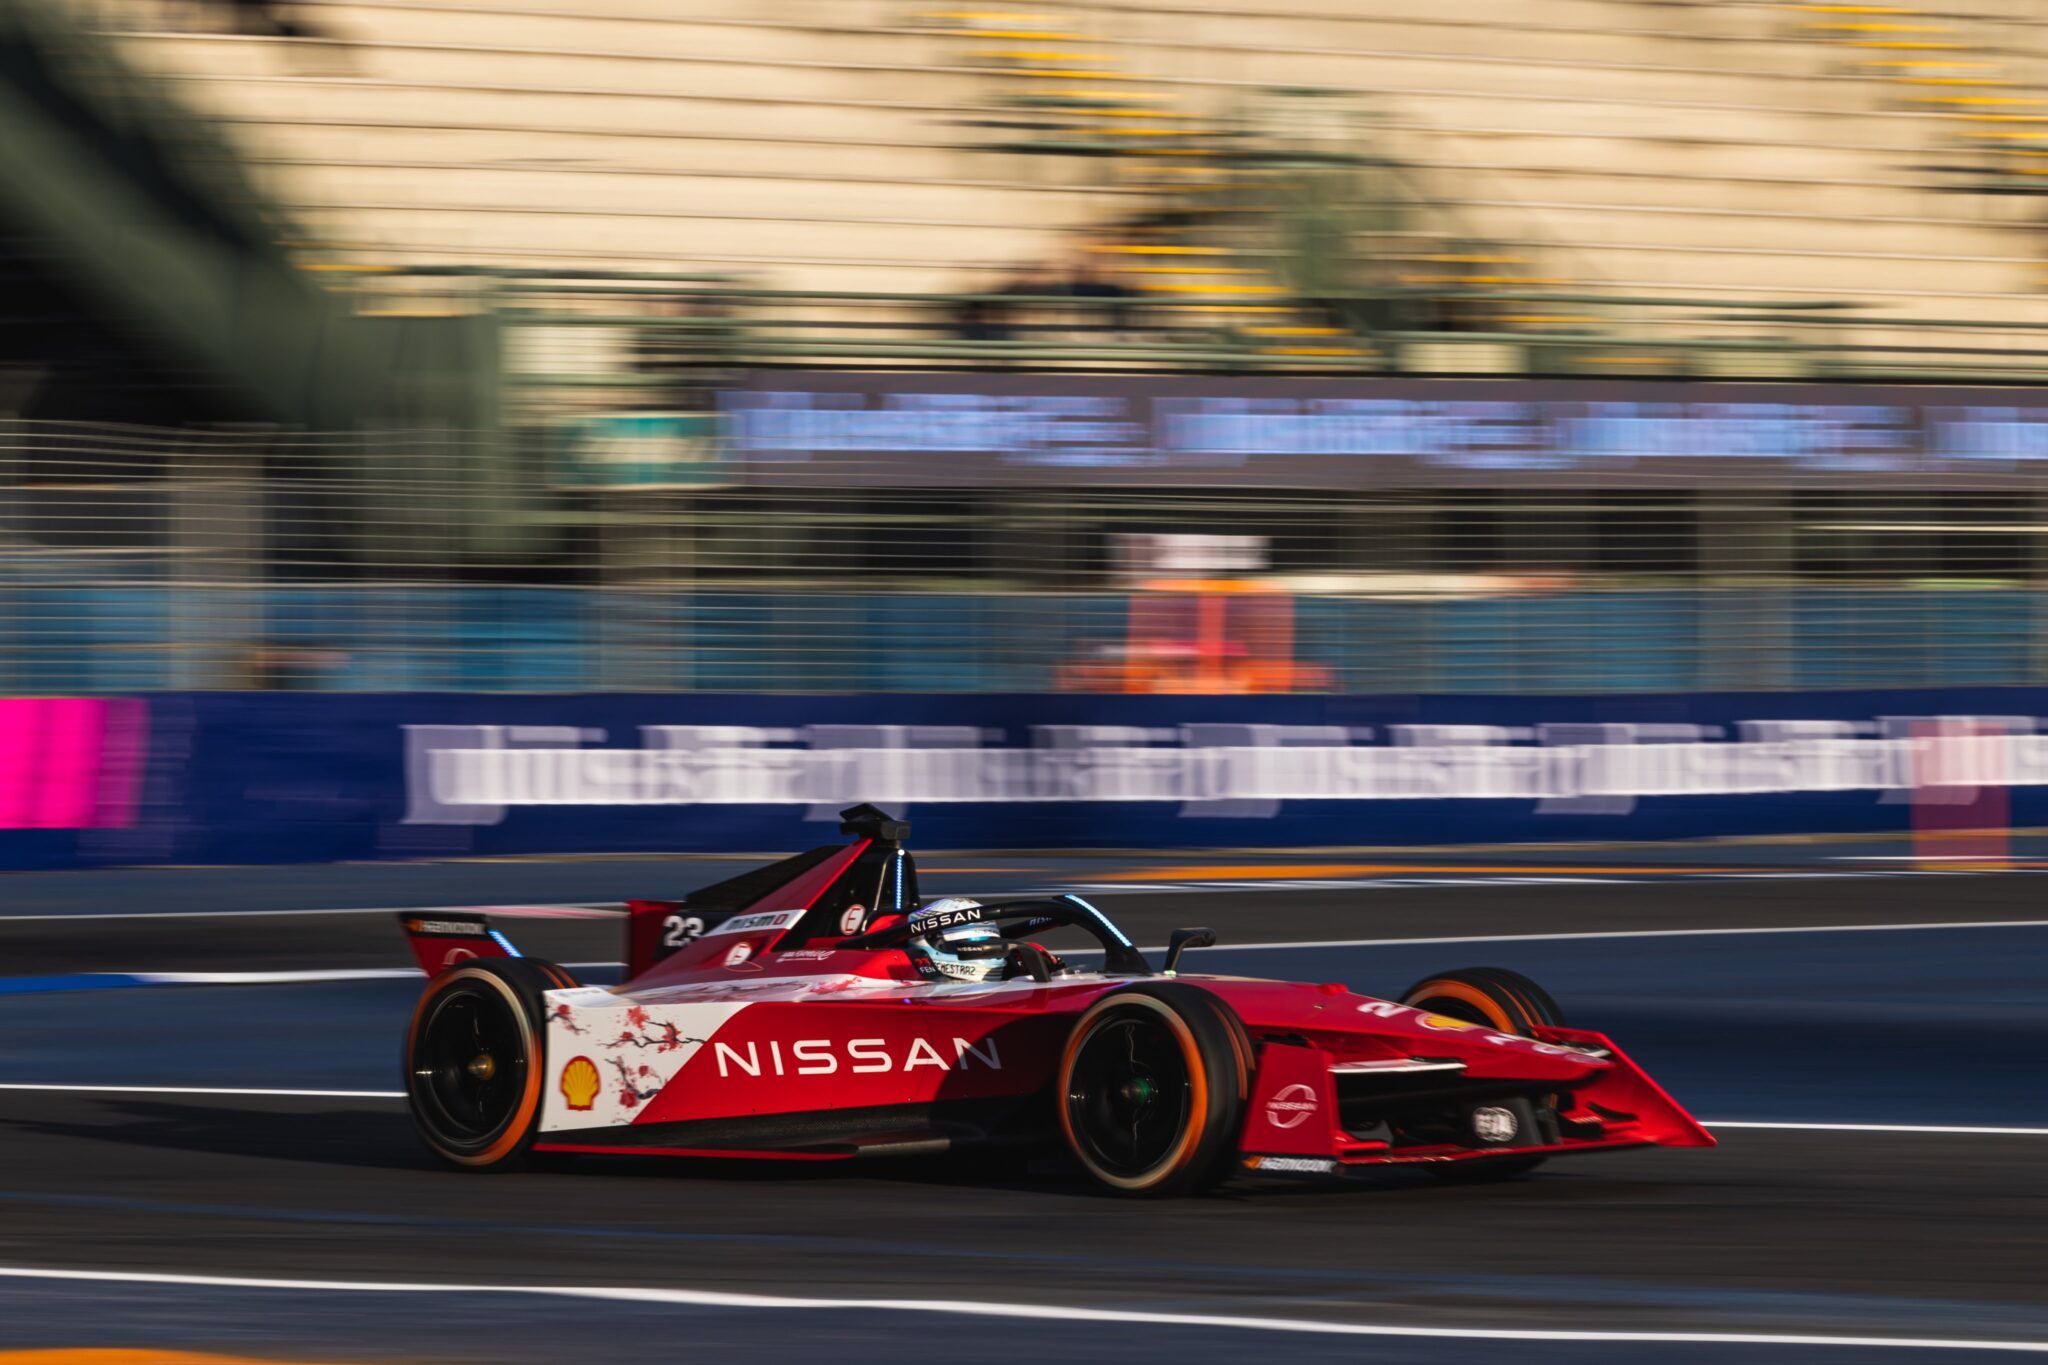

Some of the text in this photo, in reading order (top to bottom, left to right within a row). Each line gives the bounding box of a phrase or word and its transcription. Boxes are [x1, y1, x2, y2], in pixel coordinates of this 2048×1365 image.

[663, 915, 704, 947] 23
[910, 909, 981, 934] NISSAN
[714, 1037, 1002, 1078] NISSAN
